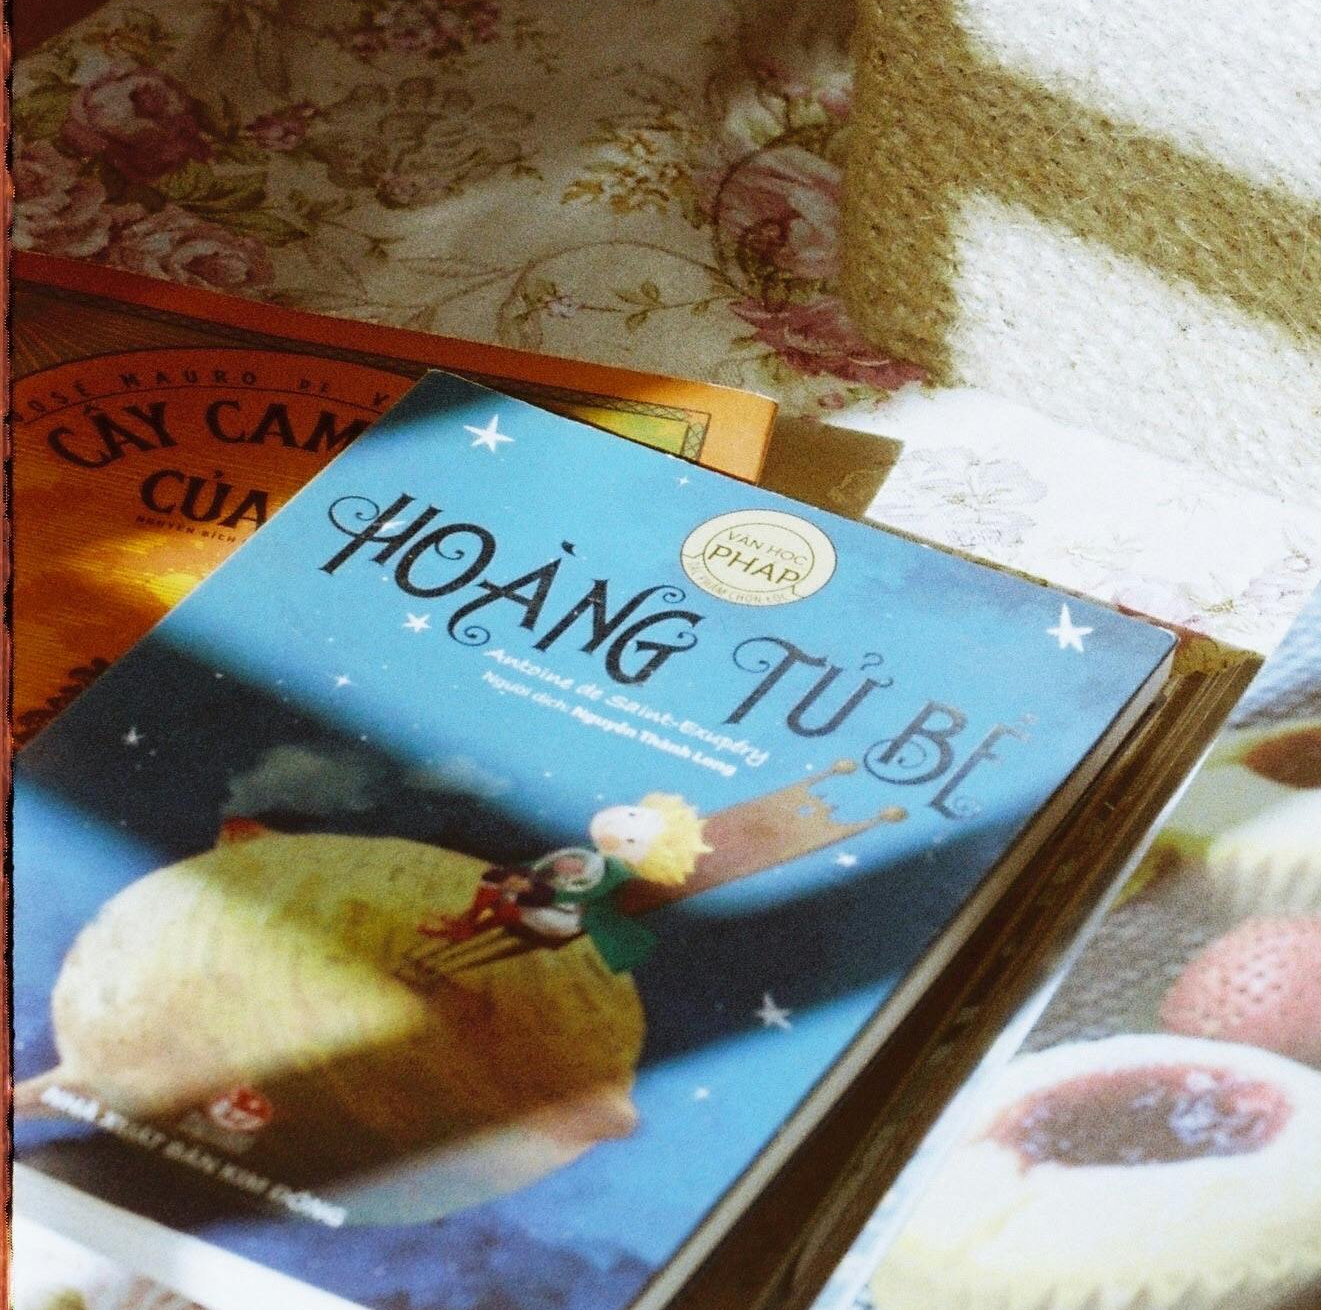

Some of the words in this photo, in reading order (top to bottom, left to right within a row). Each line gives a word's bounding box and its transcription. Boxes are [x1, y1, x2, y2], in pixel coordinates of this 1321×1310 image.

[119, 369, 257, 387] MAURO
[318, 492, 705, 685] HOÀNG
[484, 644, 575, 689] Antoine
